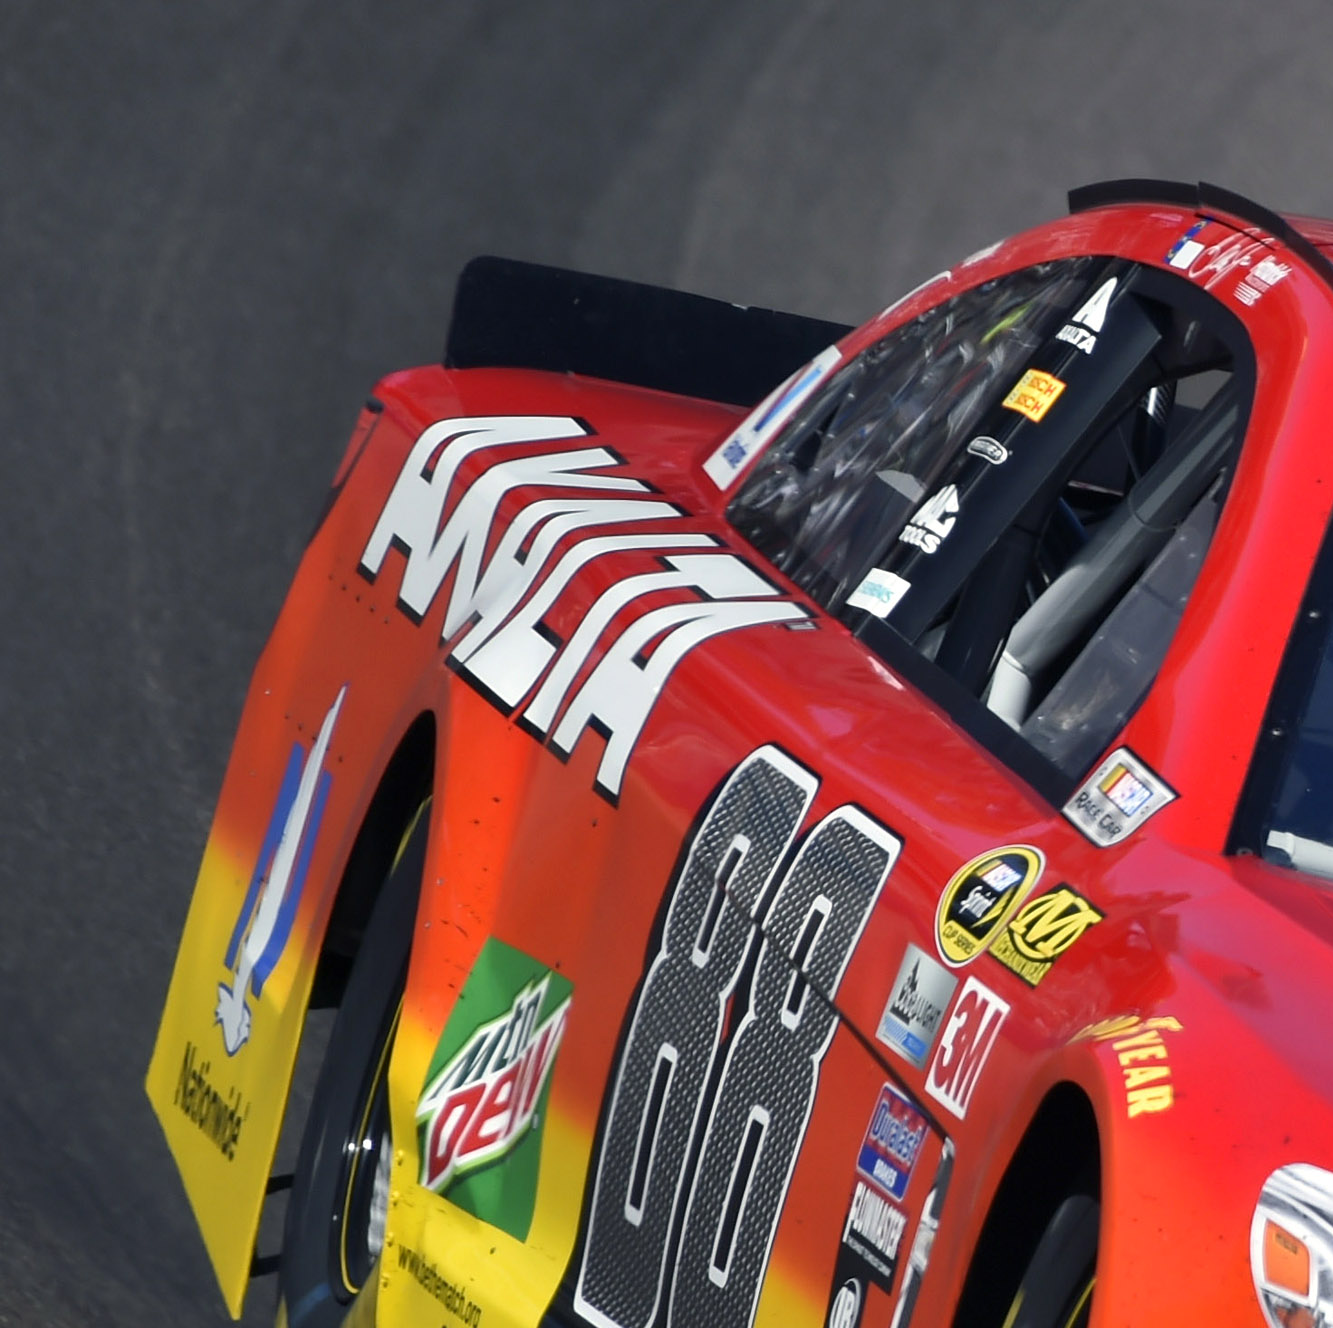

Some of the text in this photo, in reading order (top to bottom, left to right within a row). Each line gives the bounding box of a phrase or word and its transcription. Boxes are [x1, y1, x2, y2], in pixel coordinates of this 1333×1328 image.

[358, 415, 815, 805] AXALTA
[1097, 813, 1123, 839] CAR
[932, 989, 1004, 1109] 3M
